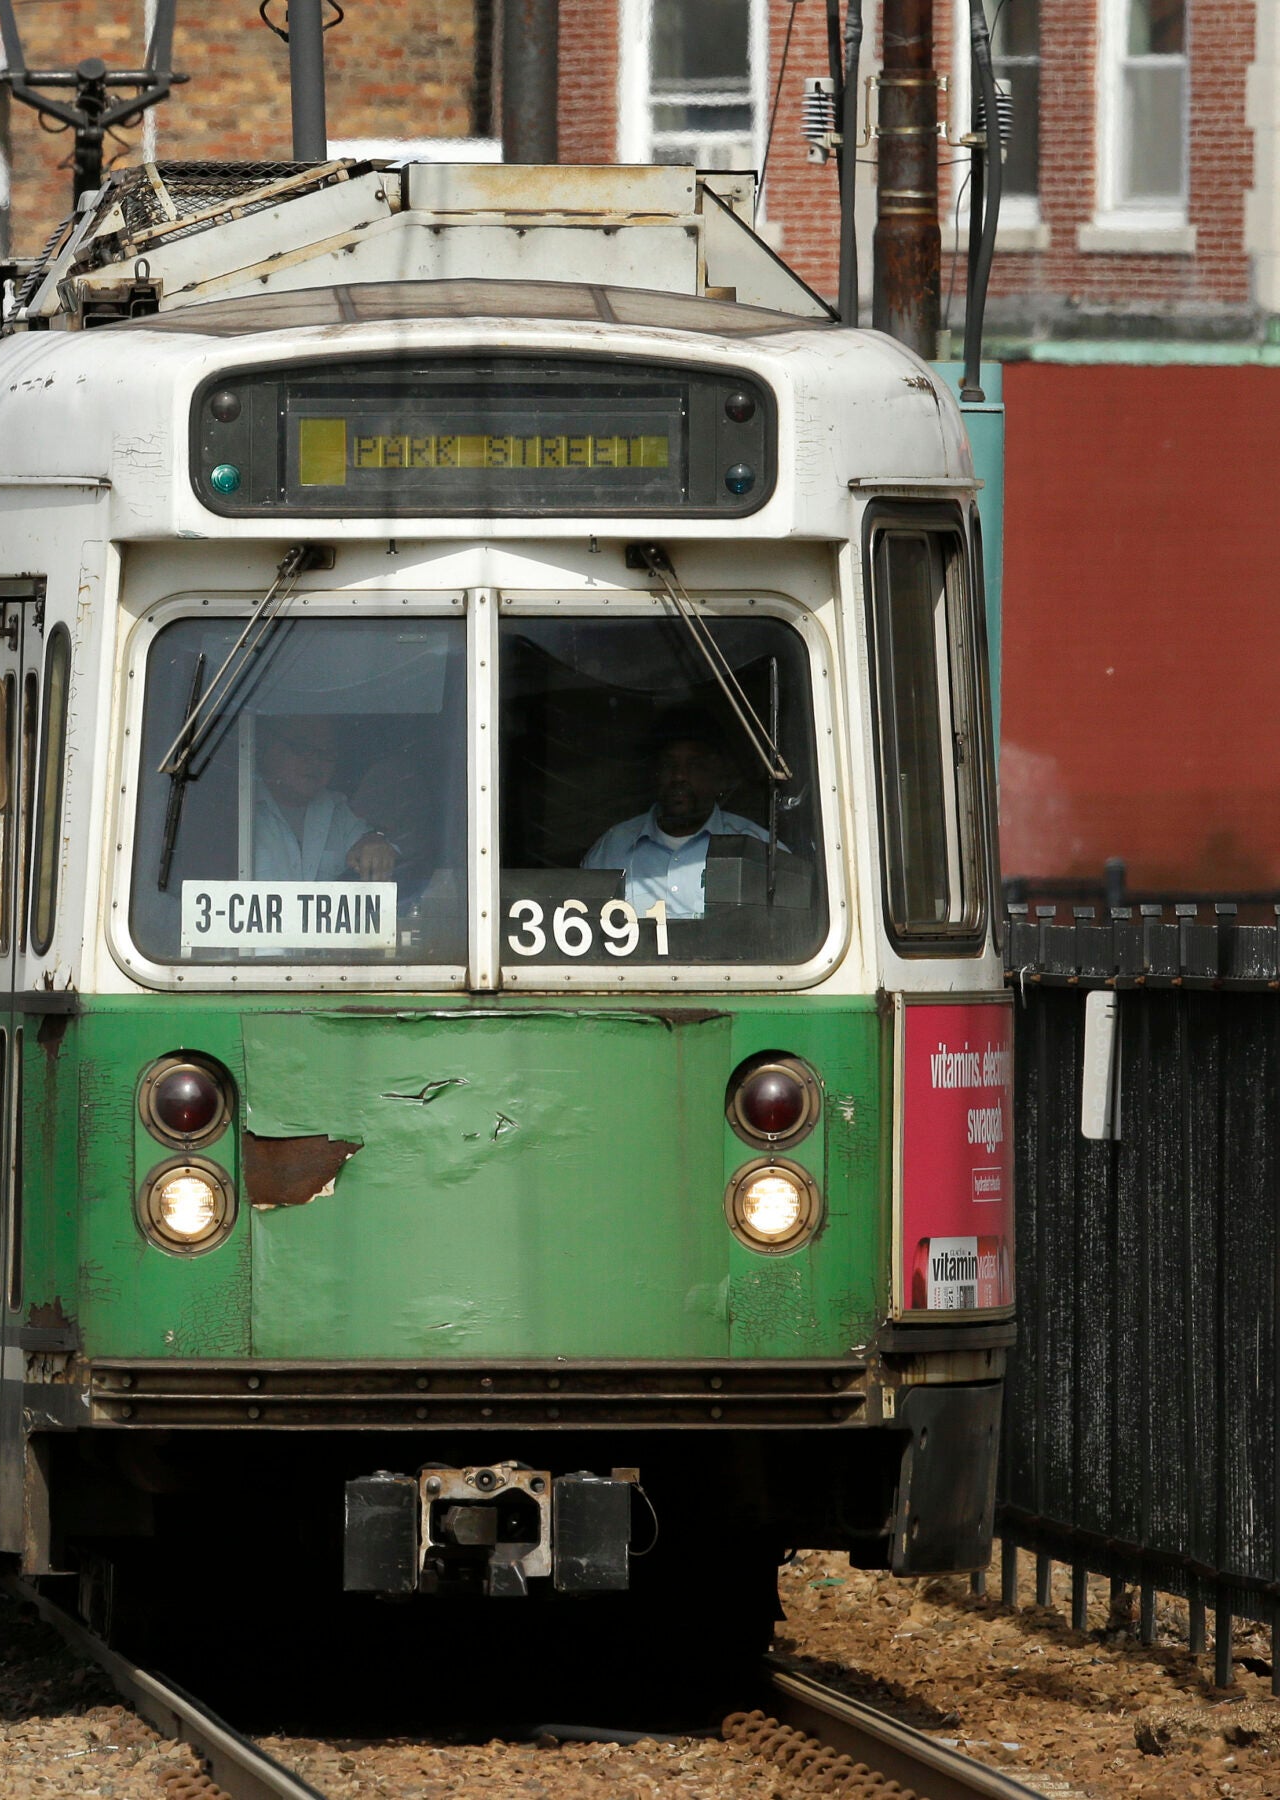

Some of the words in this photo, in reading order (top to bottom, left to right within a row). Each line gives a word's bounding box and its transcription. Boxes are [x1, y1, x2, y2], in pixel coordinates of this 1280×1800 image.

[356, 436, 457, 467] PARK
[487, 436, 637, 467] STREET
[195, 893, 283, 935] 3-CAR
[297, 893, 381, 935] TRAIN
[507, 898, 669, 957] 3691
